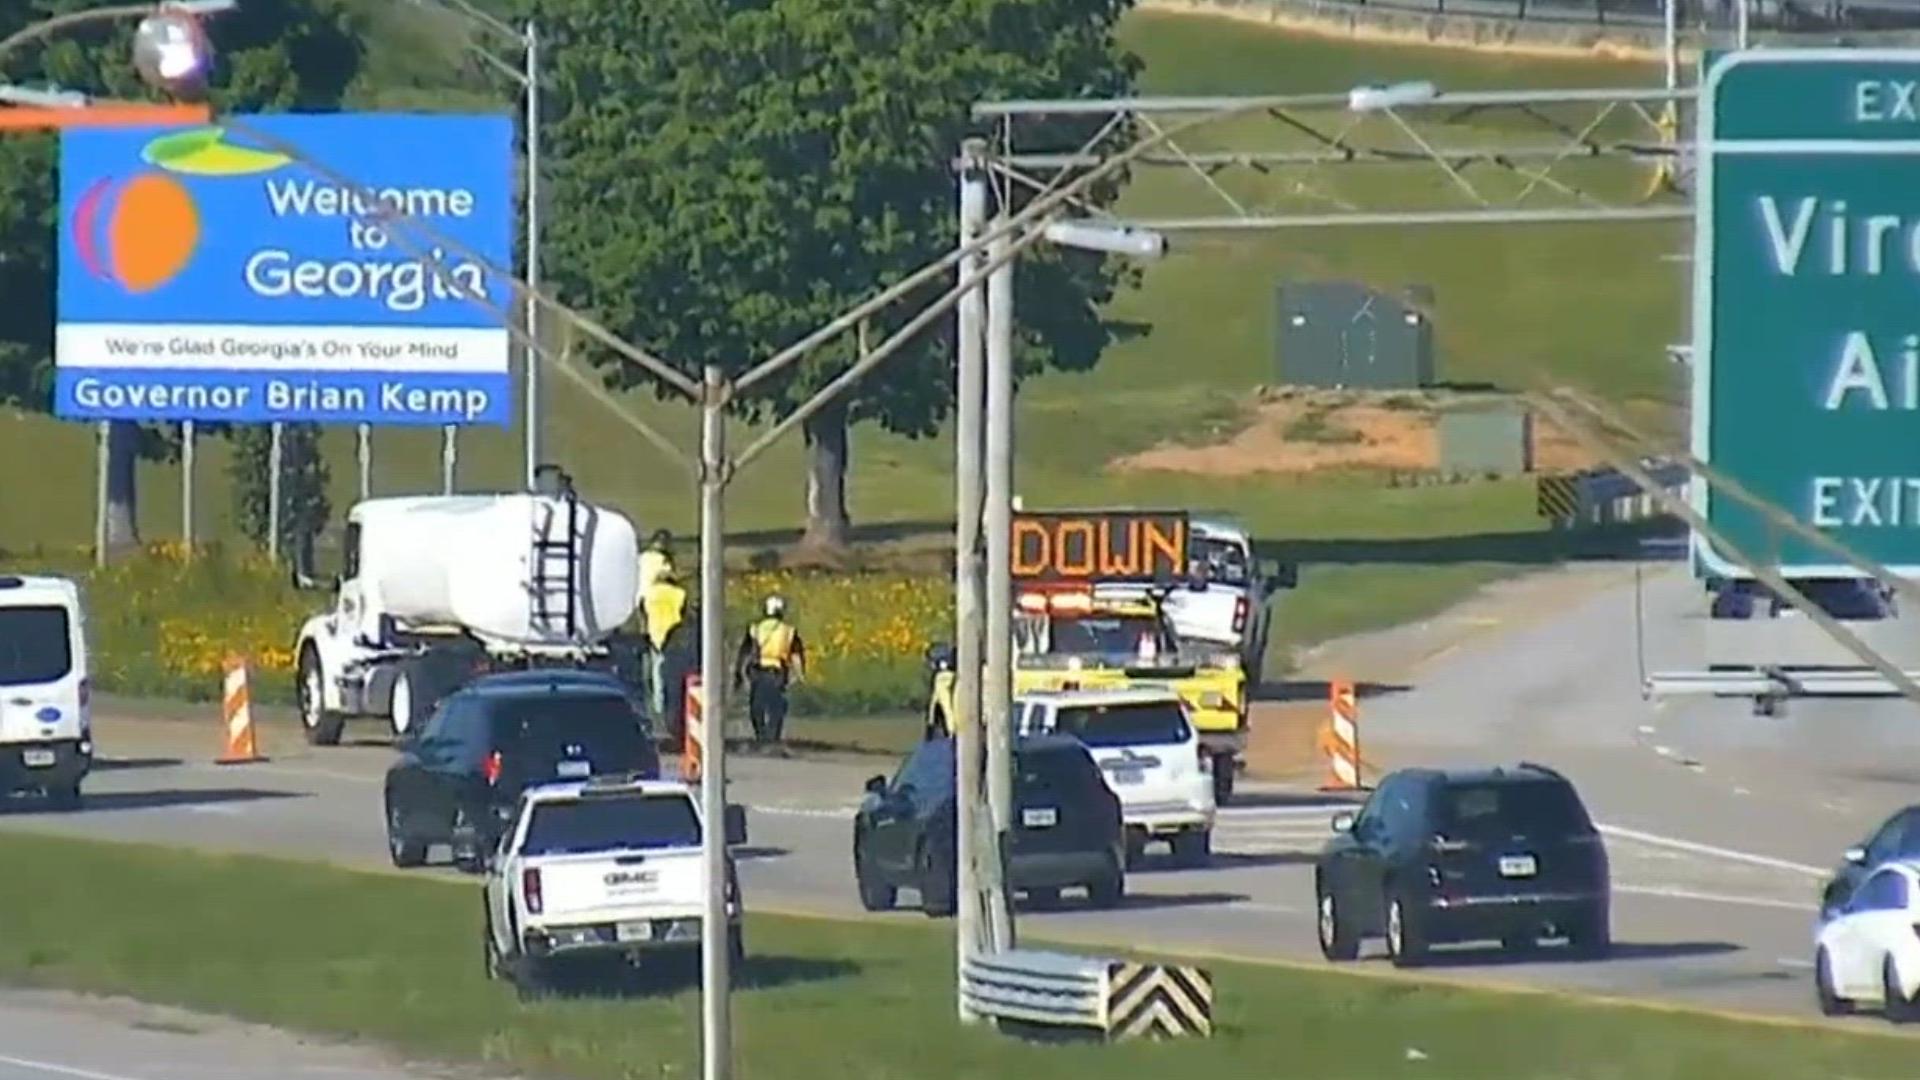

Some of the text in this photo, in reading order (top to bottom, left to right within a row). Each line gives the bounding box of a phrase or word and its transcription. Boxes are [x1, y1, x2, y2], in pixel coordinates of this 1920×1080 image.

[266, 178, 474, 217] Welcome
[351, 219, 388, 249] to
[1758, 195, 1920, 276] Vir
[245, 247, 487, 312] Georgia
[105, 336, 458, 359] We're Glad Georgia's On Your Mind
[75, 376, 488, 420] Governor Brian Kemp
[1011, 519, 1186, 577] DOWN
